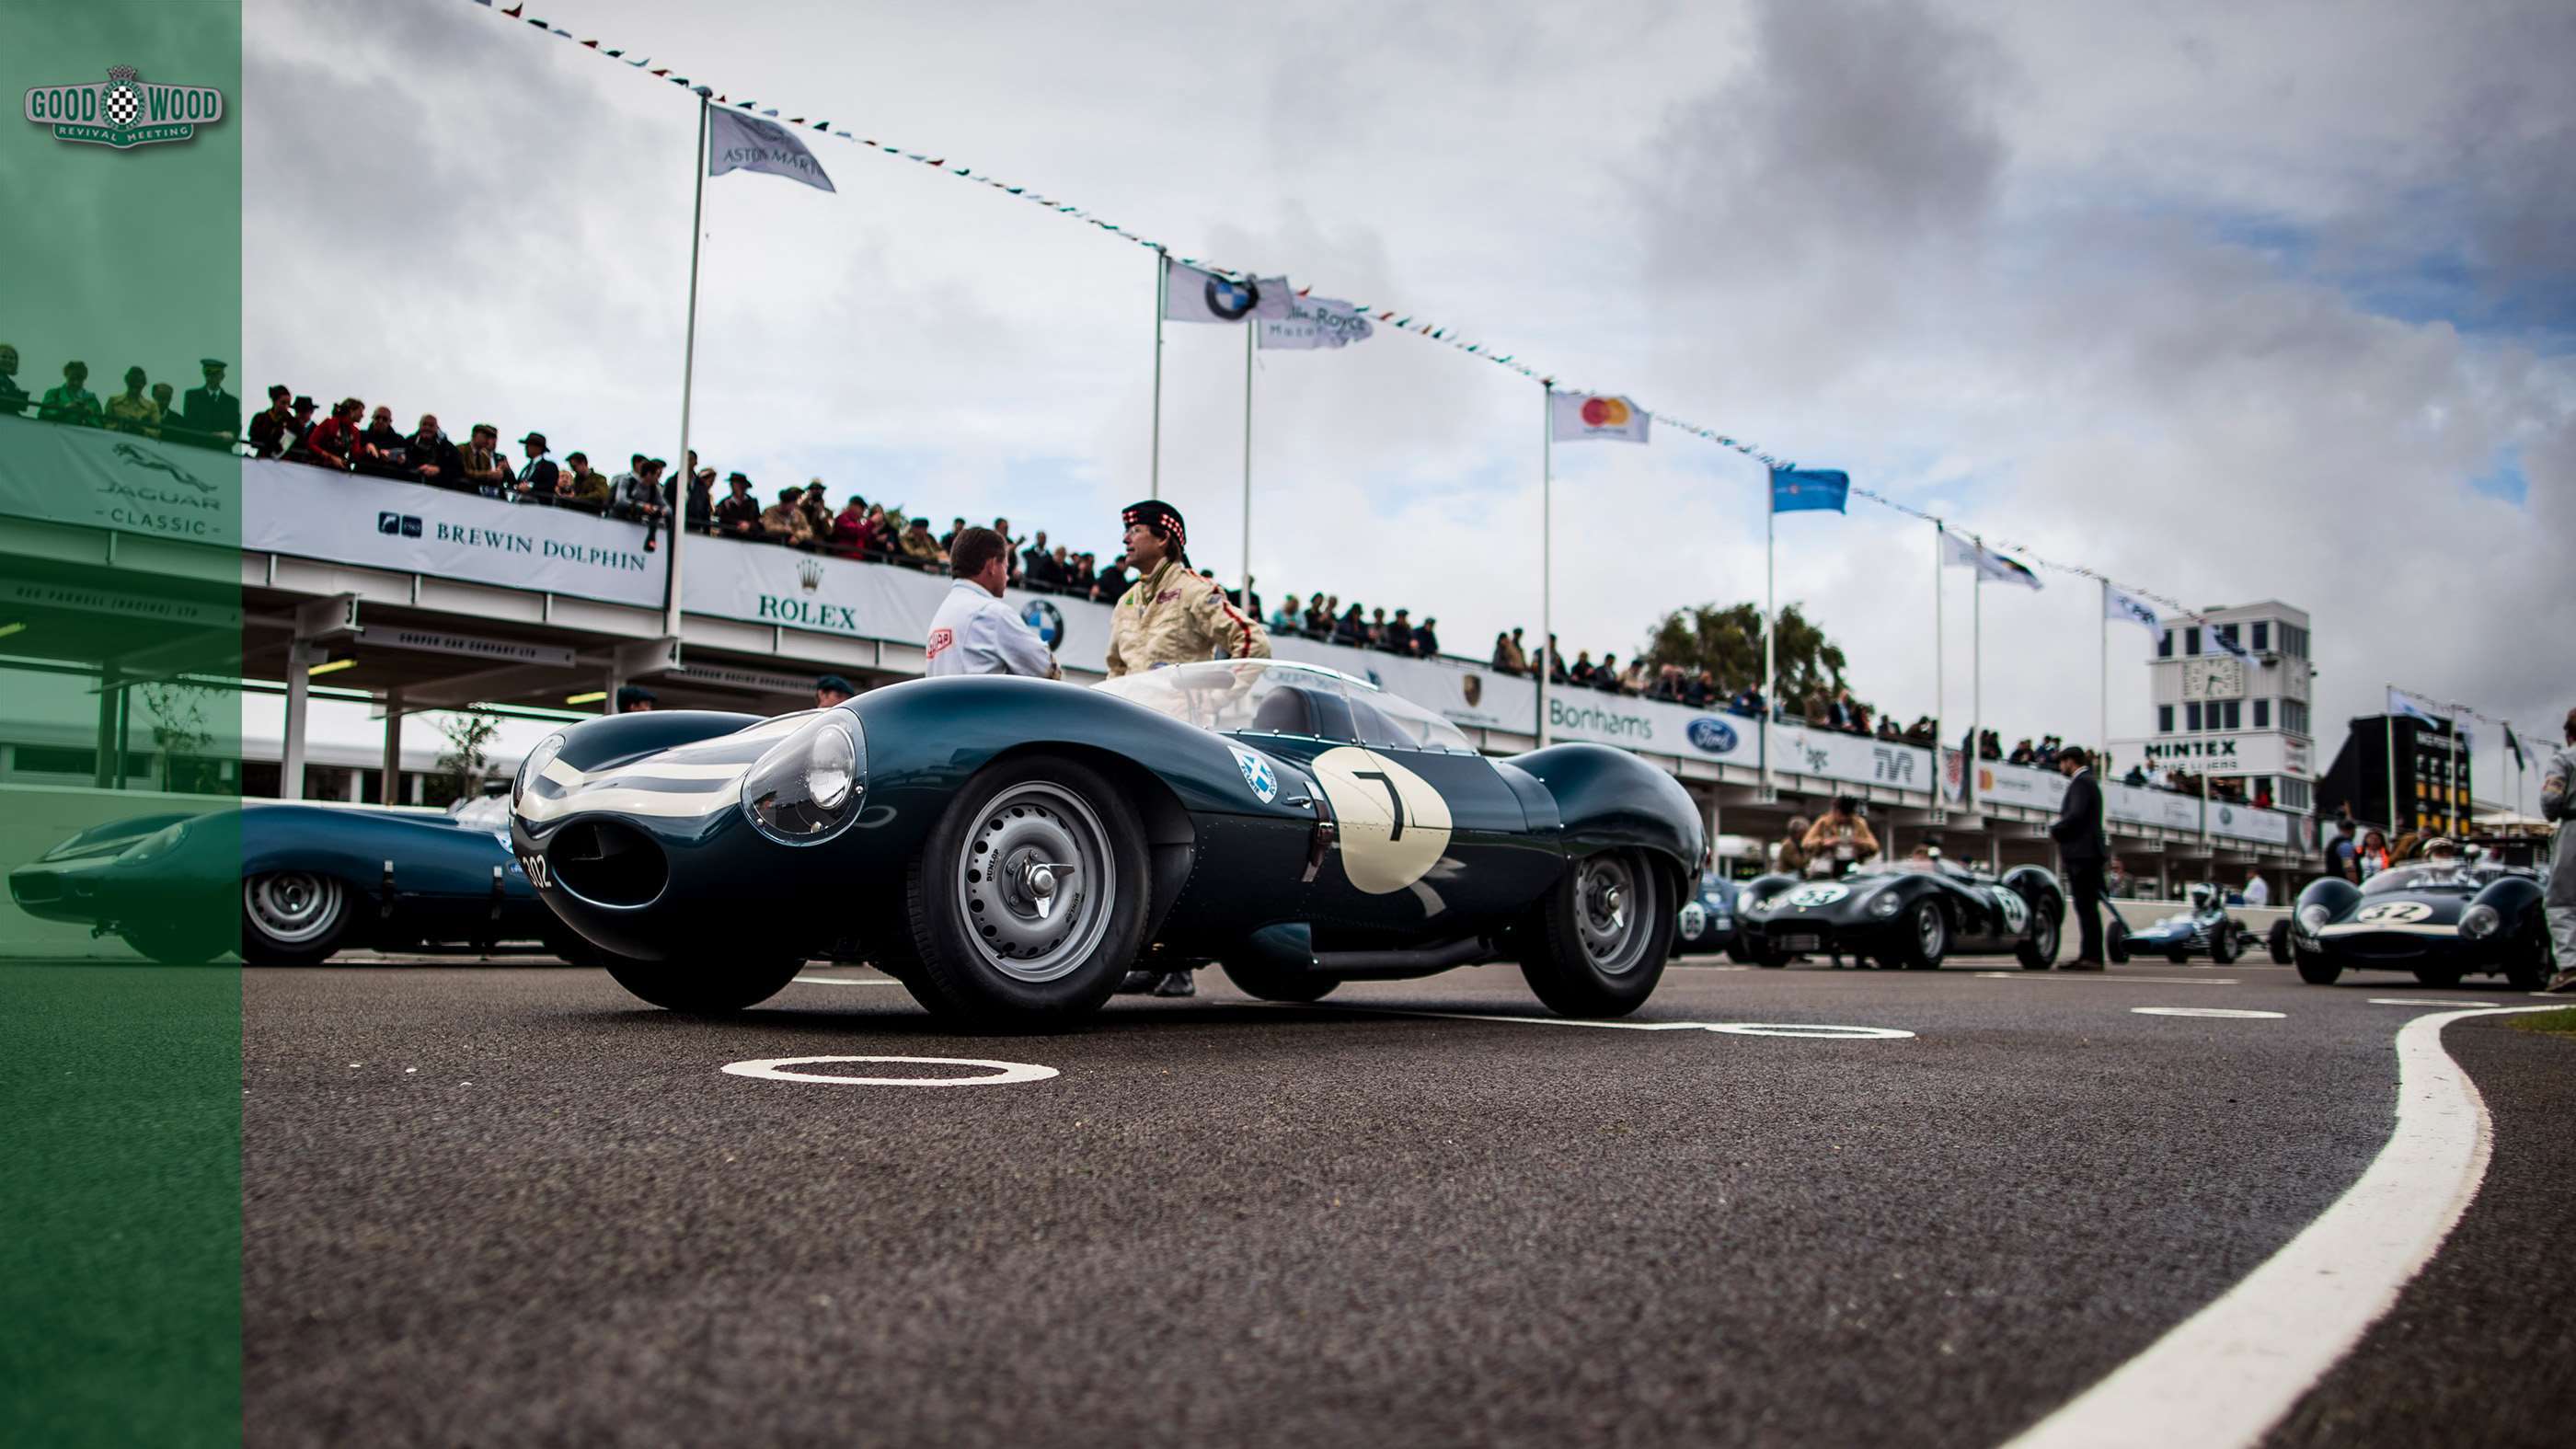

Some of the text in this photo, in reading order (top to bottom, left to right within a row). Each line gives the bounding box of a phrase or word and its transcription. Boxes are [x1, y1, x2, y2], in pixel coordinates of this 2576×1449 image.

[96, 481, 221, 511] JAGUAR
[111, 507, 206, 535] CLASSIC
[436, 522, 646, 572] BREWIN DOLPHIN
[757, 593, 857, 630] ROLEX
[1549, 697, 1653, 739] Bonhams
[1873, 747, 1915, 784] TVR
[2145, 739, 2237, 758] MINTEX
[1351, 771, 1405, 842] 7
[986, 848, 999, 882] DUNLOP
[2362, 903, 2416, 921] 32
